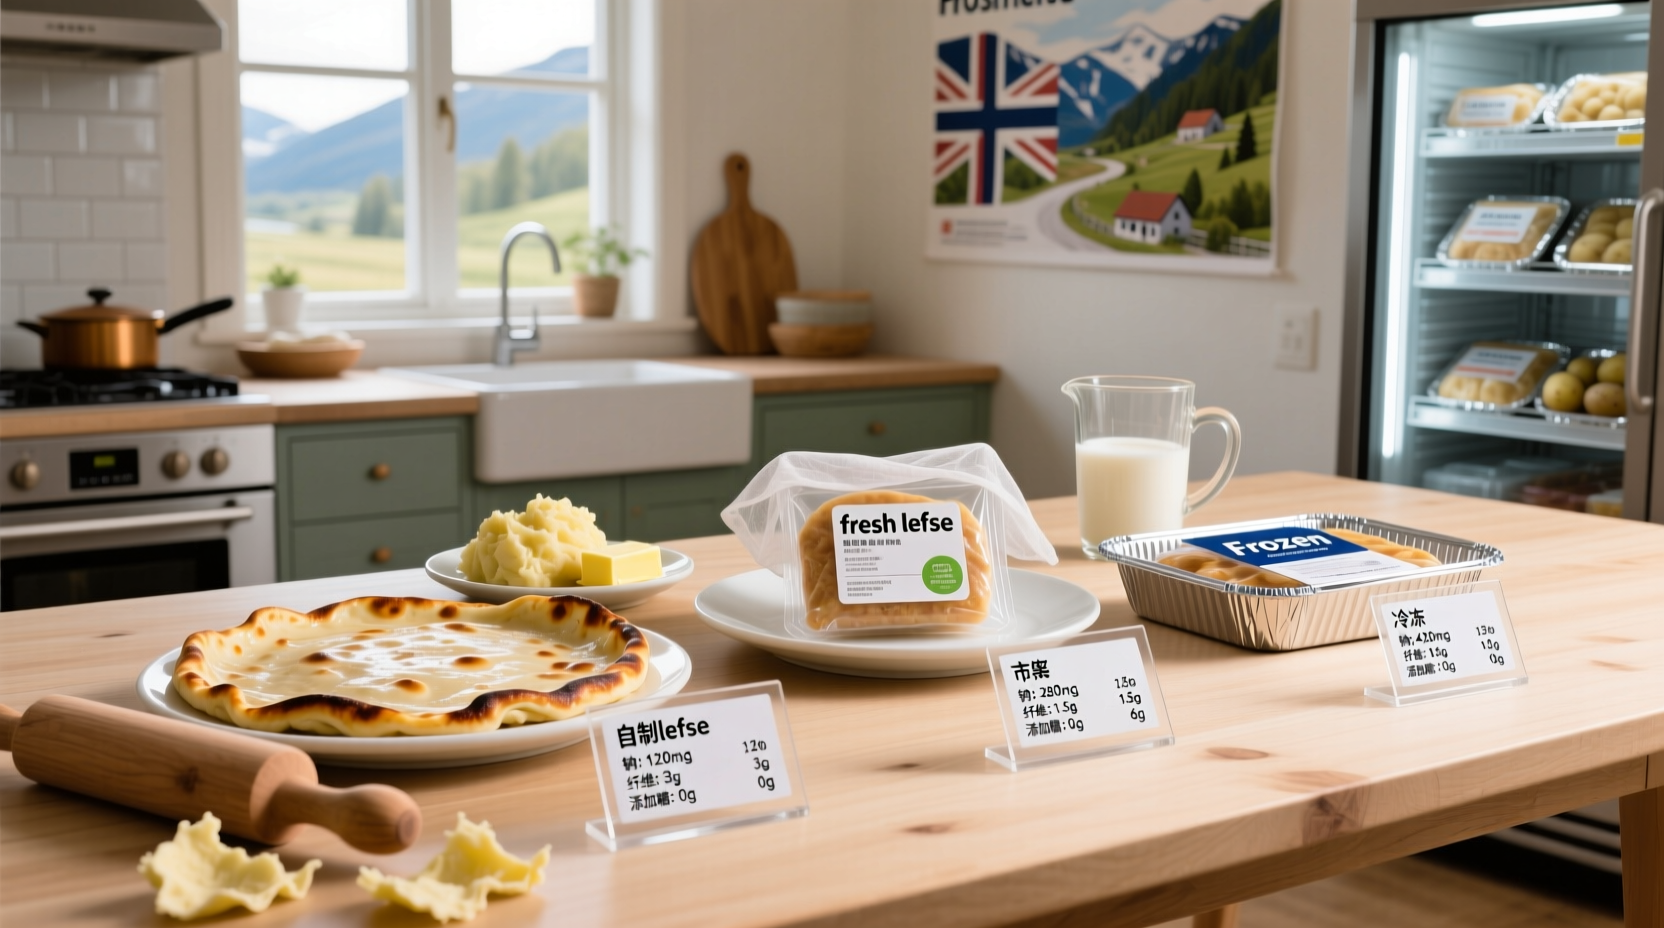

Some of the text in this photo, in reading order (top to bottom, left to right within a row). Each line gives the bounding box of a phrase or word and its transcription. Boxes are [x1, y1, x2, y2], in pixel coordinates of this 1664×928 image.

[840, 511, 953, 534] fresh lefse
[1222, 533, 1332, 556] Frozen
[1391, 607, 1426, 628] 冷冻
[1067, 717, 1084, 732] 0g
[1130, 707, 1146, 723] 6g
[617, 717, 710, 749] 自制lefse
[646, 750, 693, 767] 120mg
[662, 770, 681, 786] 3g
[753, 756, 770, 772] 3g
[678, 788, 697, 804] 0g
[757, 775, 775, 791] 0g
